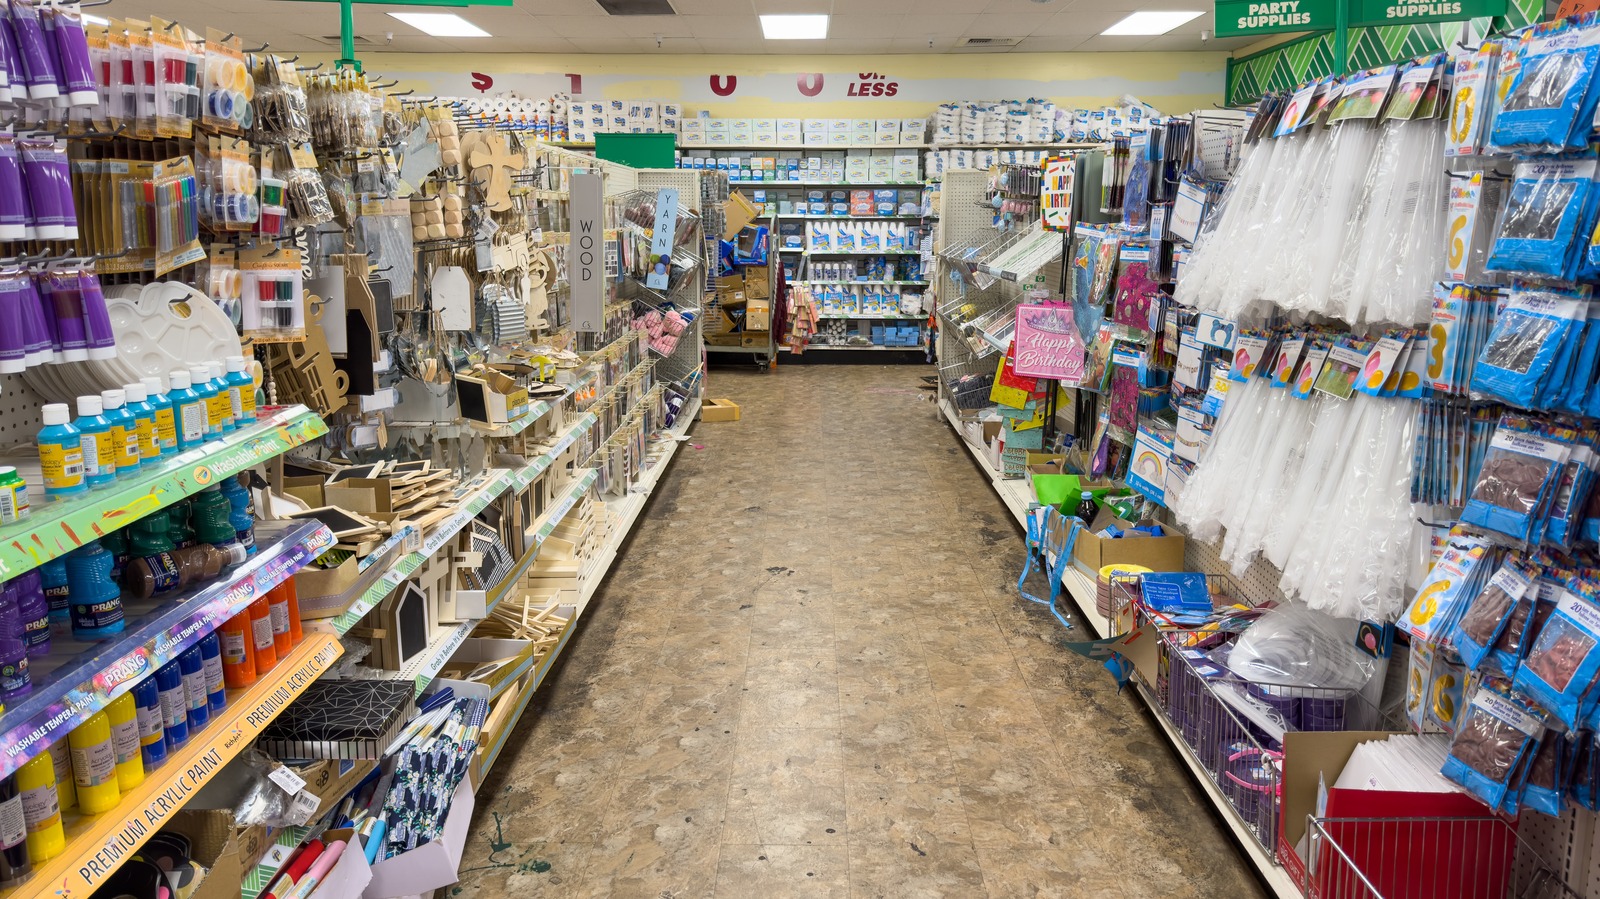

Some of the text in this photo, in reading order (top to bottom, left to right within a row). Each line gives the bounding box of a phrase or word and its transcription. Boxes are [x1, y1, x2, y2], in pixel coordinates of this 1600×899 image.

[1237, 12, 1311, 29] SUPPLIES
[1248, 1, 1300, 16] PARTY
[1386, 2, 1462, 18] SUPPLIES
[847, 82, 899, 97] LESS
[658, 194, 671, 248] YARN
[579, 219, 594, 281] WOOD
[1025, 332, 1076, 355] Happy
[1018, 349, 1082, 375] Birthday
[1504, 434, 1514, 442] 20
[207, 448, 258, 476] Washable
[307, 530, 331, 550] PRANG
[159, 551, 178, 576] PRANG
[92, 597, 120, 612] PRANG
[223, 581, 253, 606] PRANG
[1570, 601, 1583, 613] 20
[153, 610, 218, 657] WASHABLE TEMPERA PAINT
[104, 653, 147, 687] PRANG
[246, 641, 338, 729] PREMIUM ACRYLIC PAINT
[1484, 696, 1494, 705] 20
[6, 692, 96, 758] WASHABLE TEMPERA PAINT
[224, 733, 243, 749] RichArt
[78, 748, 223, 885] PREMIUM ACRYLIC PAINT
